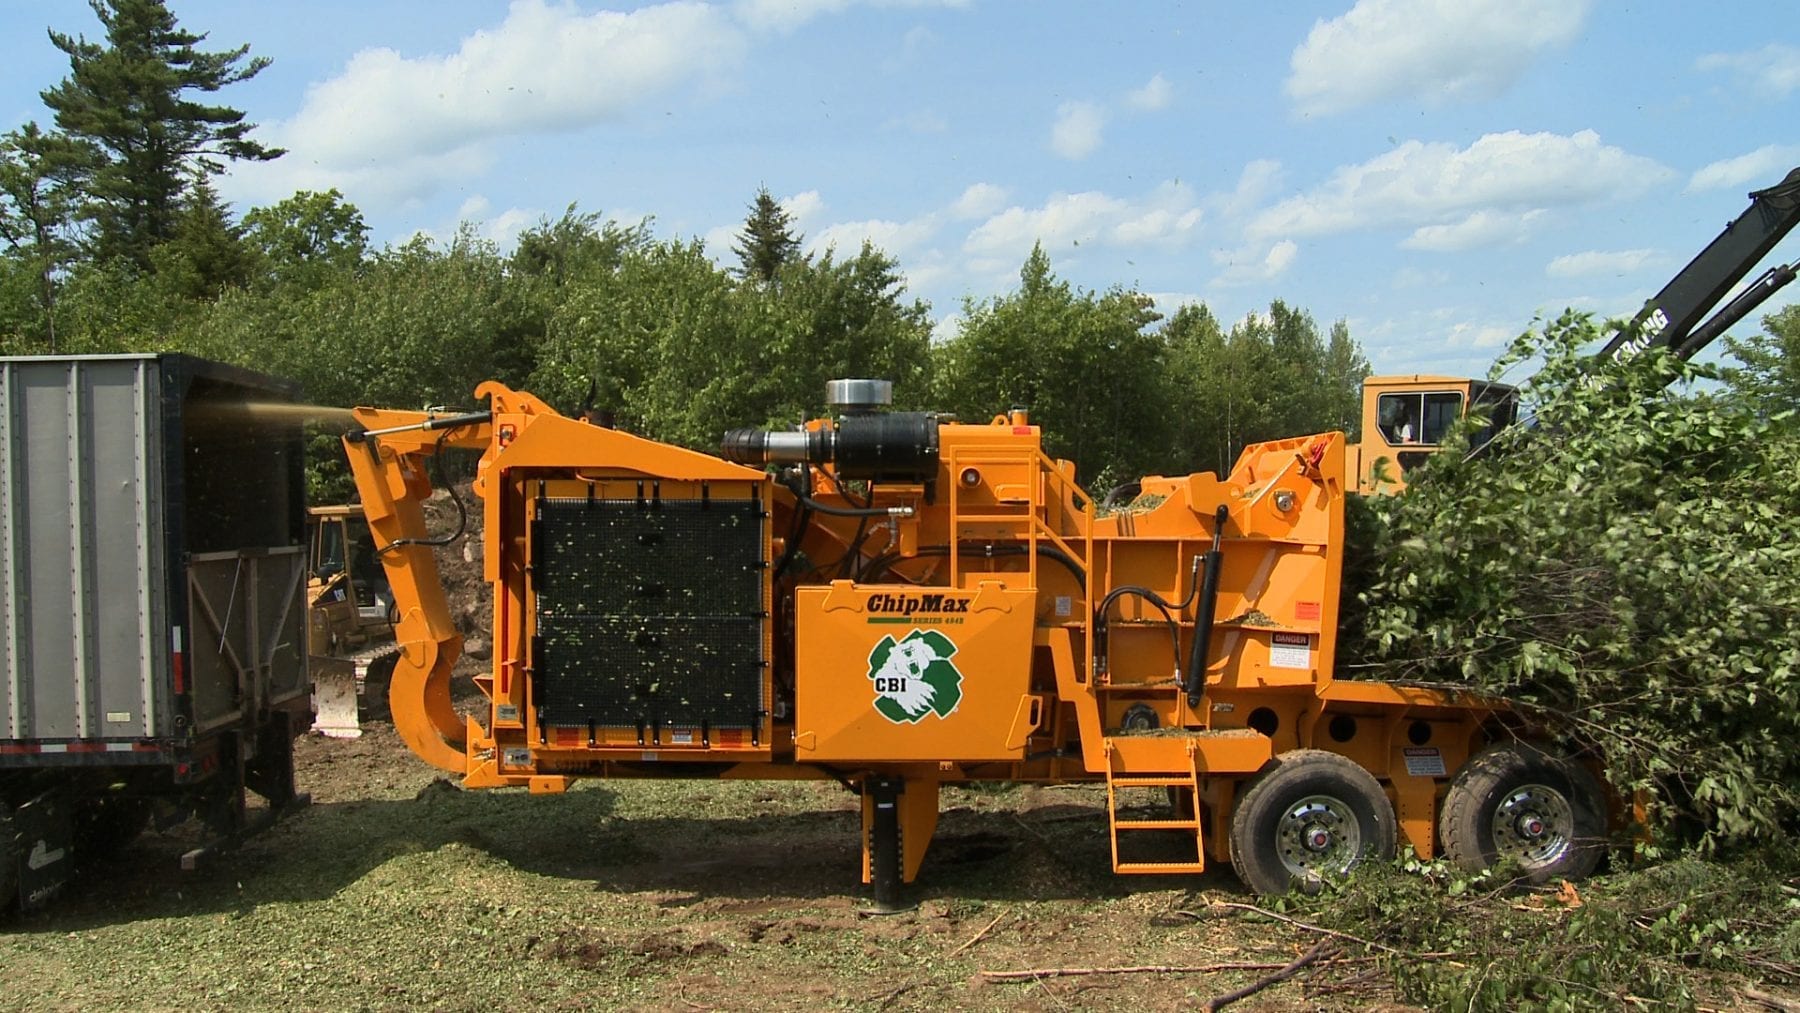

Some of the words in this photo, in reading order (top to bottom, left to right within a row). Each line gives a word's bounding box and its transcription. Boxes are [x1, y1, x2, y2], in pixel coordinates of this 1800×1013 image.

[867, 594, 970, 615] ChipMax
[913, 616, 943, 625] SERIES
[1275, 634, 1305, 644] DANGER
[875, 677, 907, 692] CBI
